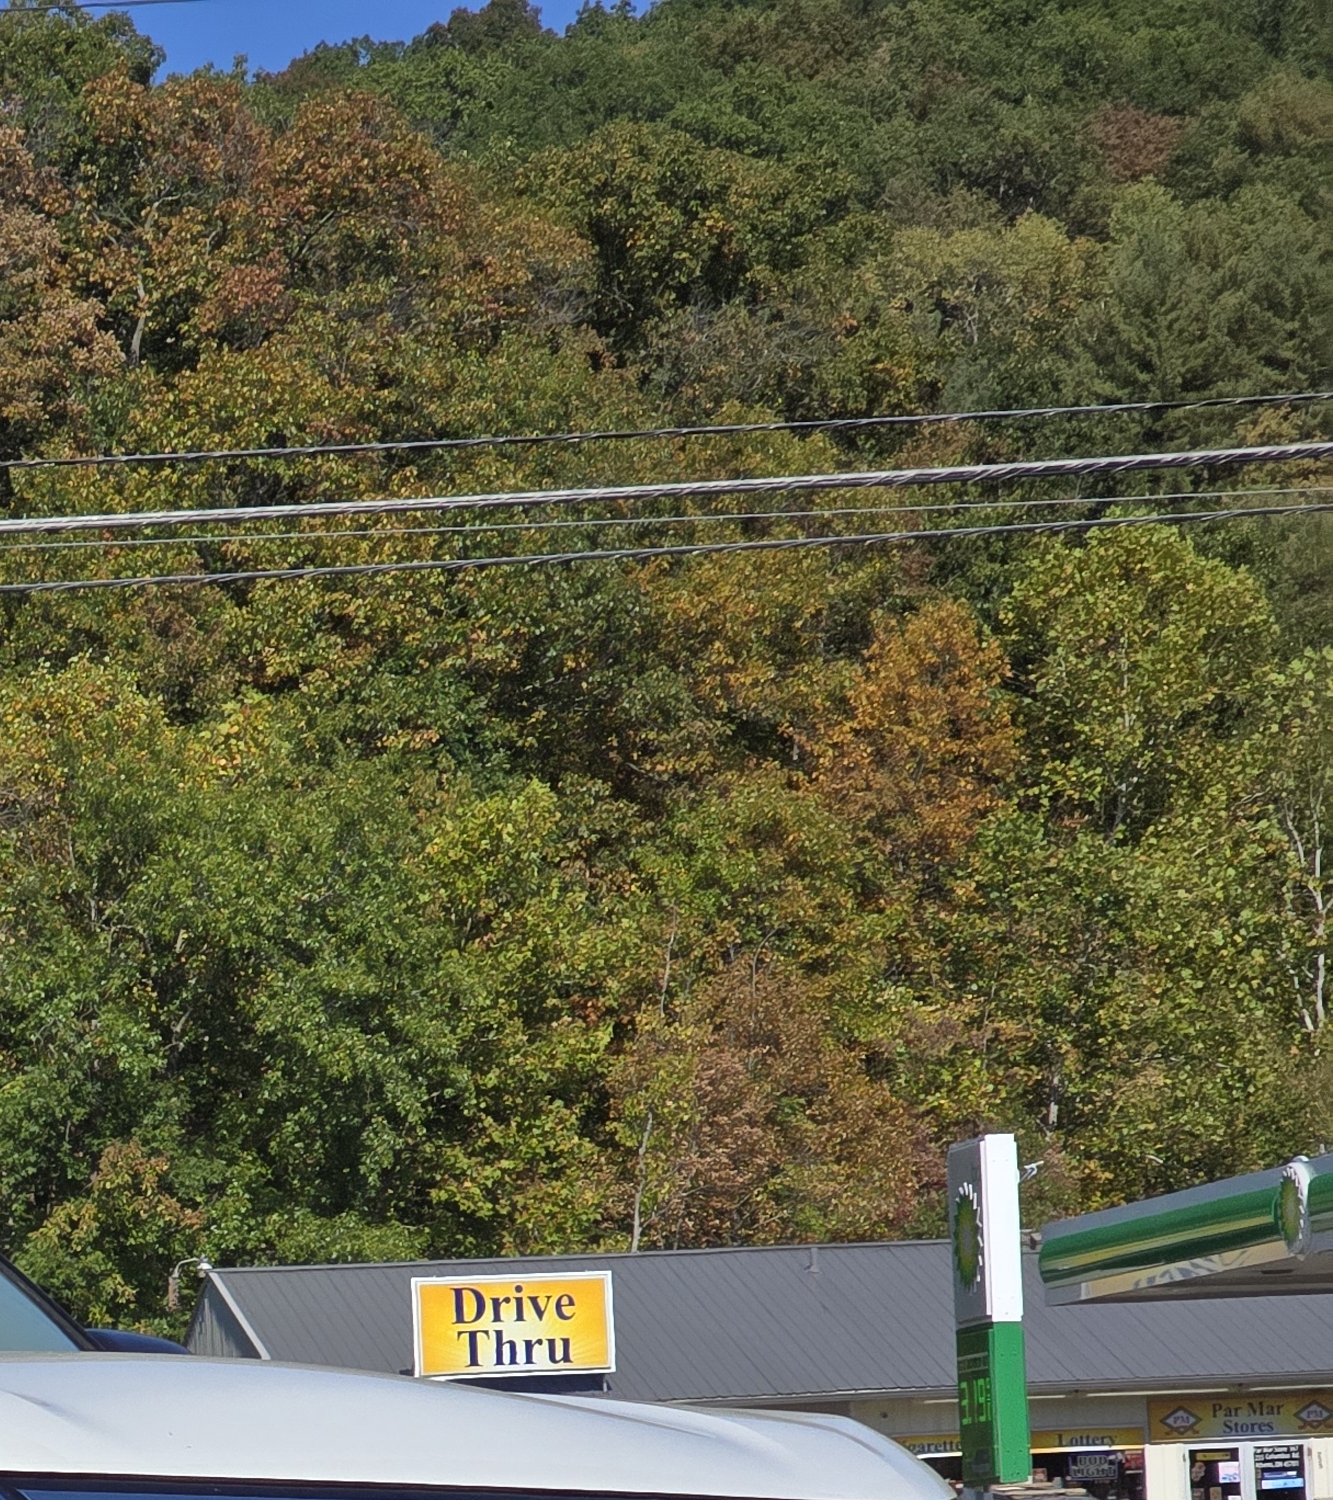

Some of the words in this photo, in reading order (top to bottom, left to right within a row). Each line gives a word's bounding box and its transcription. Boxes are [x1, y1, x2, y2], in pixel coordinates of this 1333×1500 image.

[450, 1285, 577, 1325] Drive
[457, 1329, 574, 1368] Thru
[1212, 1402, 1243, 1418] Par
[1247, 1401, 1285, 1417] Mar
[1222, 1419, 1275, 1434] Stores
[1056, 1433, 1118, 1448] Lottery
